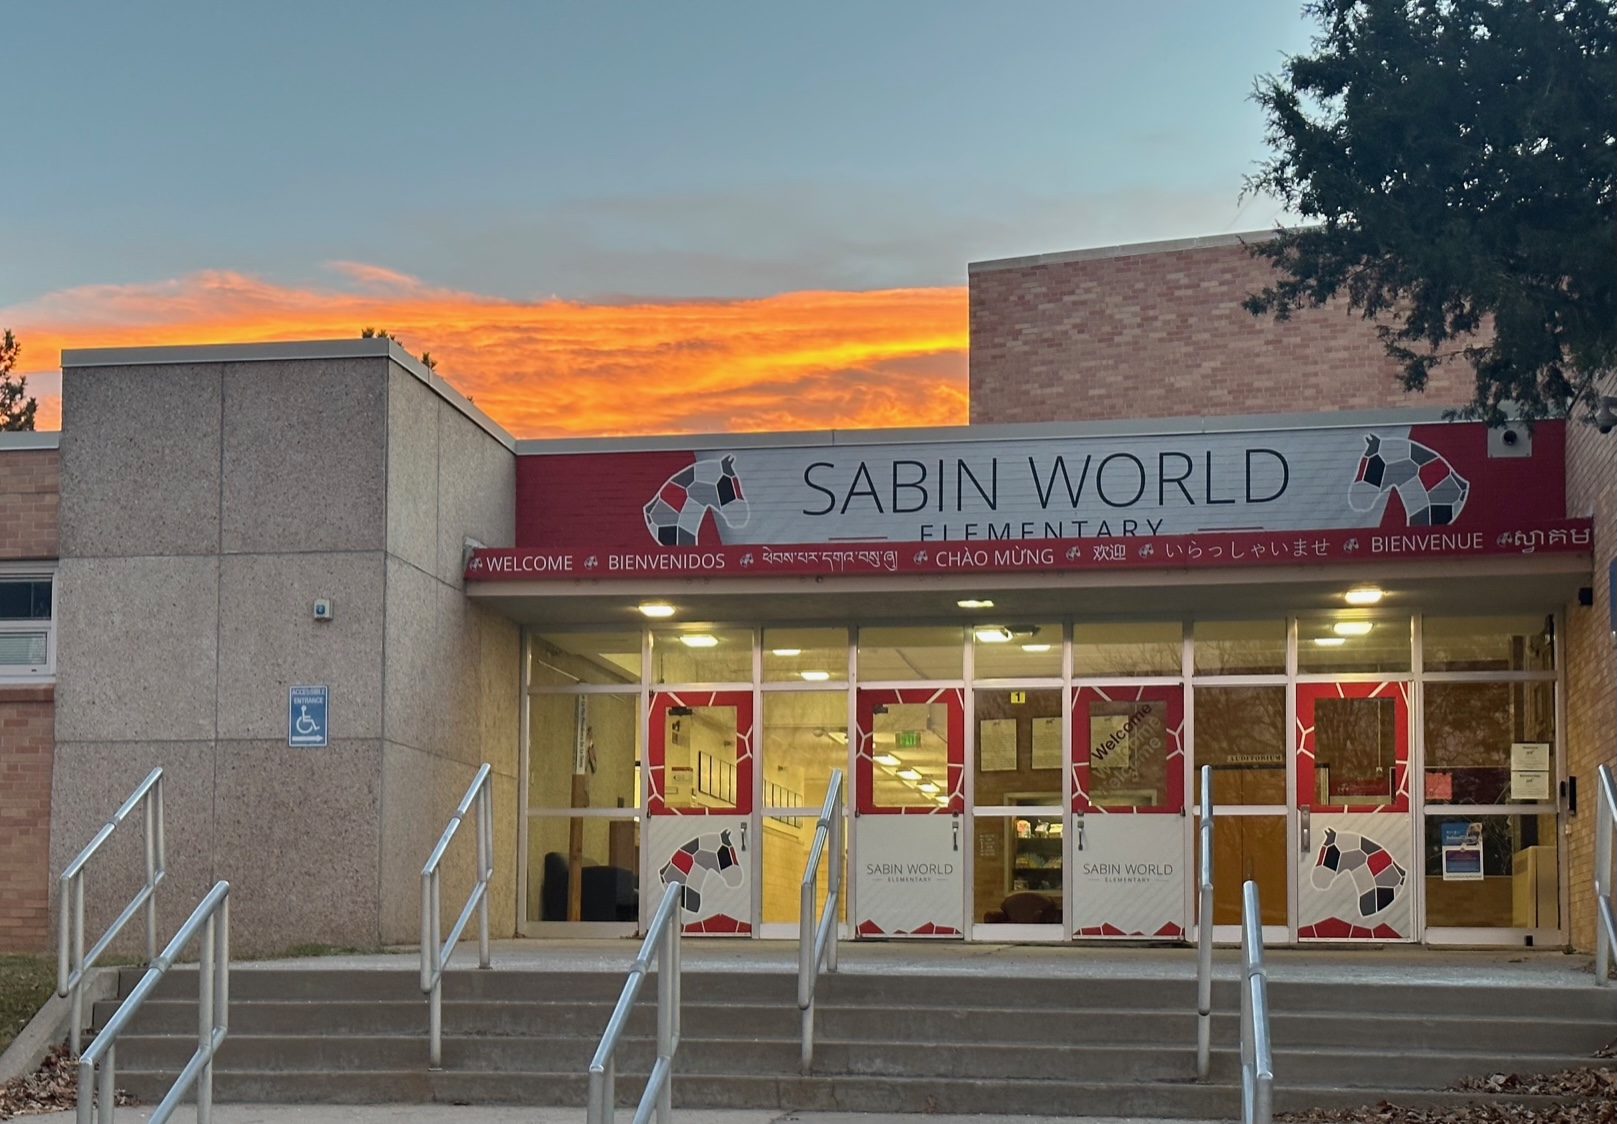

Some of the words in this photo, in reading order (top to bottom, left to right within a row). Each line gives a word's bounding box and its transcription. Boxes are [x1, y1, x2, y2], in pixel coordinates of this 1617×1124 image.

[802, 456, 998, 516] SABIN
[1027, 448, 1290, 510] WORLD
[1165, 538, 1330, 559] いらっしゃいませ
[1371, 532, 1483, 553] BIENVENUE
[935, 546, 988, 567] CHÀO
[994, 545, 1054, 566] MỪNG
[1093, 543, 1127, 561] 欢迎
[486, 555, 573, 572] WELCOME
[608, 553, 726, 570] BIENVENIDOS
[293, 696, 324, 704] ENTRANCE
[1091, 703, 1152, 761] Welcome
[1230, 754, 1281, 762] AUDITORIUM
[866, 863, 903, 875] SABIN
[907, 863, 954, 875] WORLD
[1083, 863, 1121, 875] SABIN
[1125, 863, 1173, 876] WORLD
